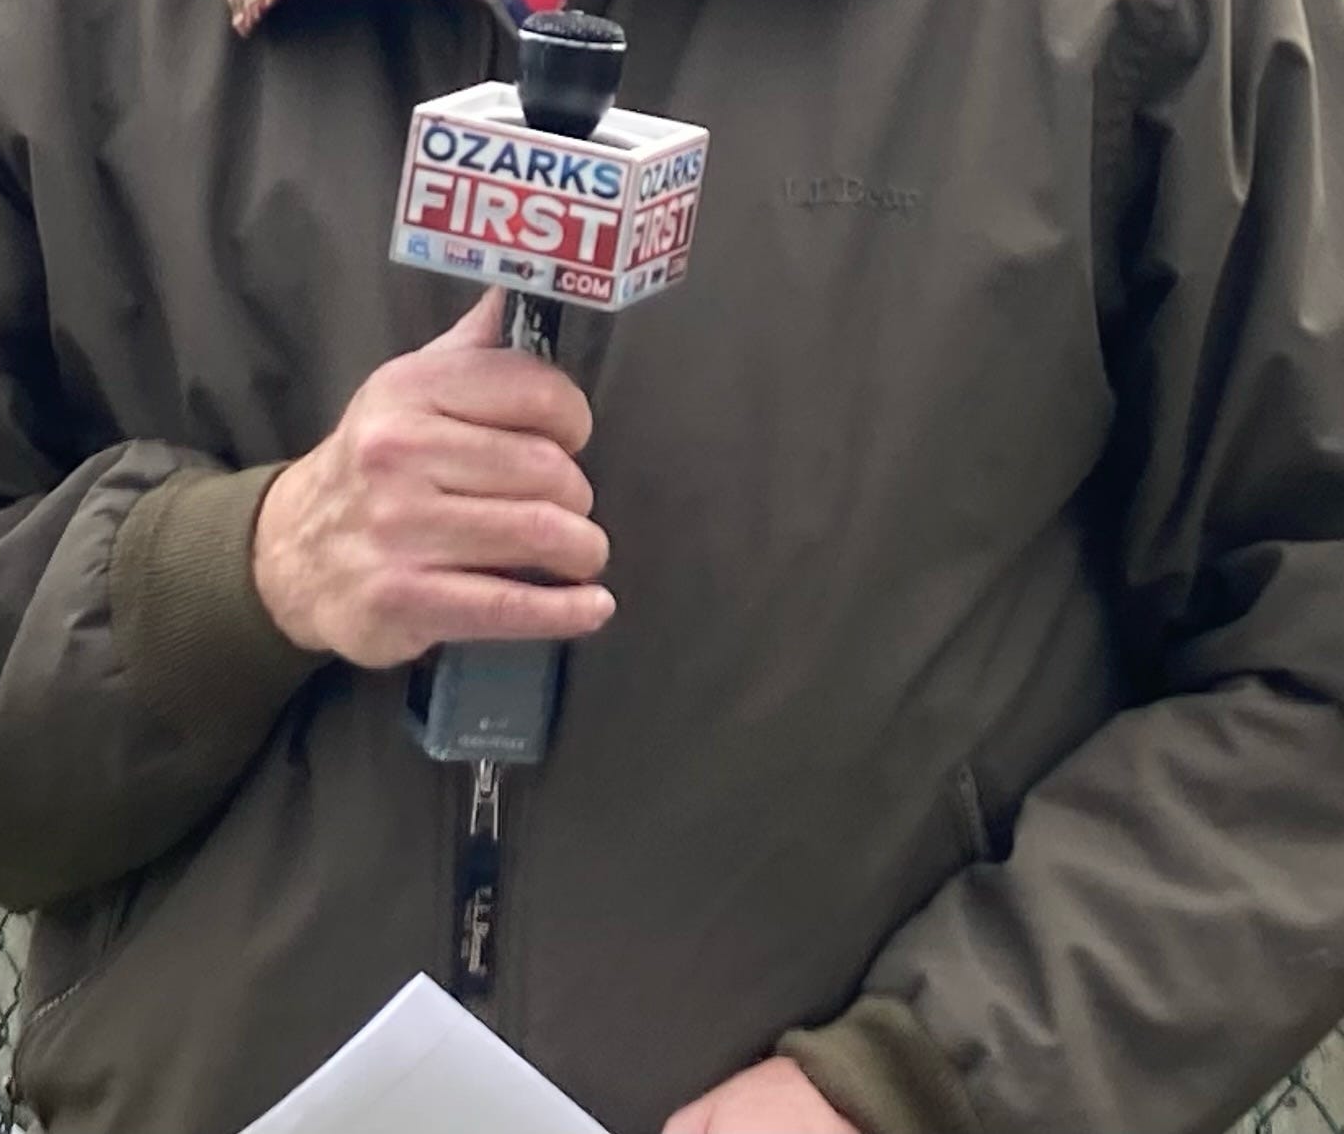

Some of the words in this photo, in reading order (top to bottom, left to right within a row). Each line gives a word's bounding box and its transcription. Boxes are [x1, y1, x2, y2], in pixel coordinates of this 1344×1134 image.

[422, 124, 623, 200] OZARKS
[639, 148, 703, 202] OZARKS
[405, 168, 618, 264] FIRST
[626, 192, 696, 268] FIRST
[555, 270, 612, 299] .COM
